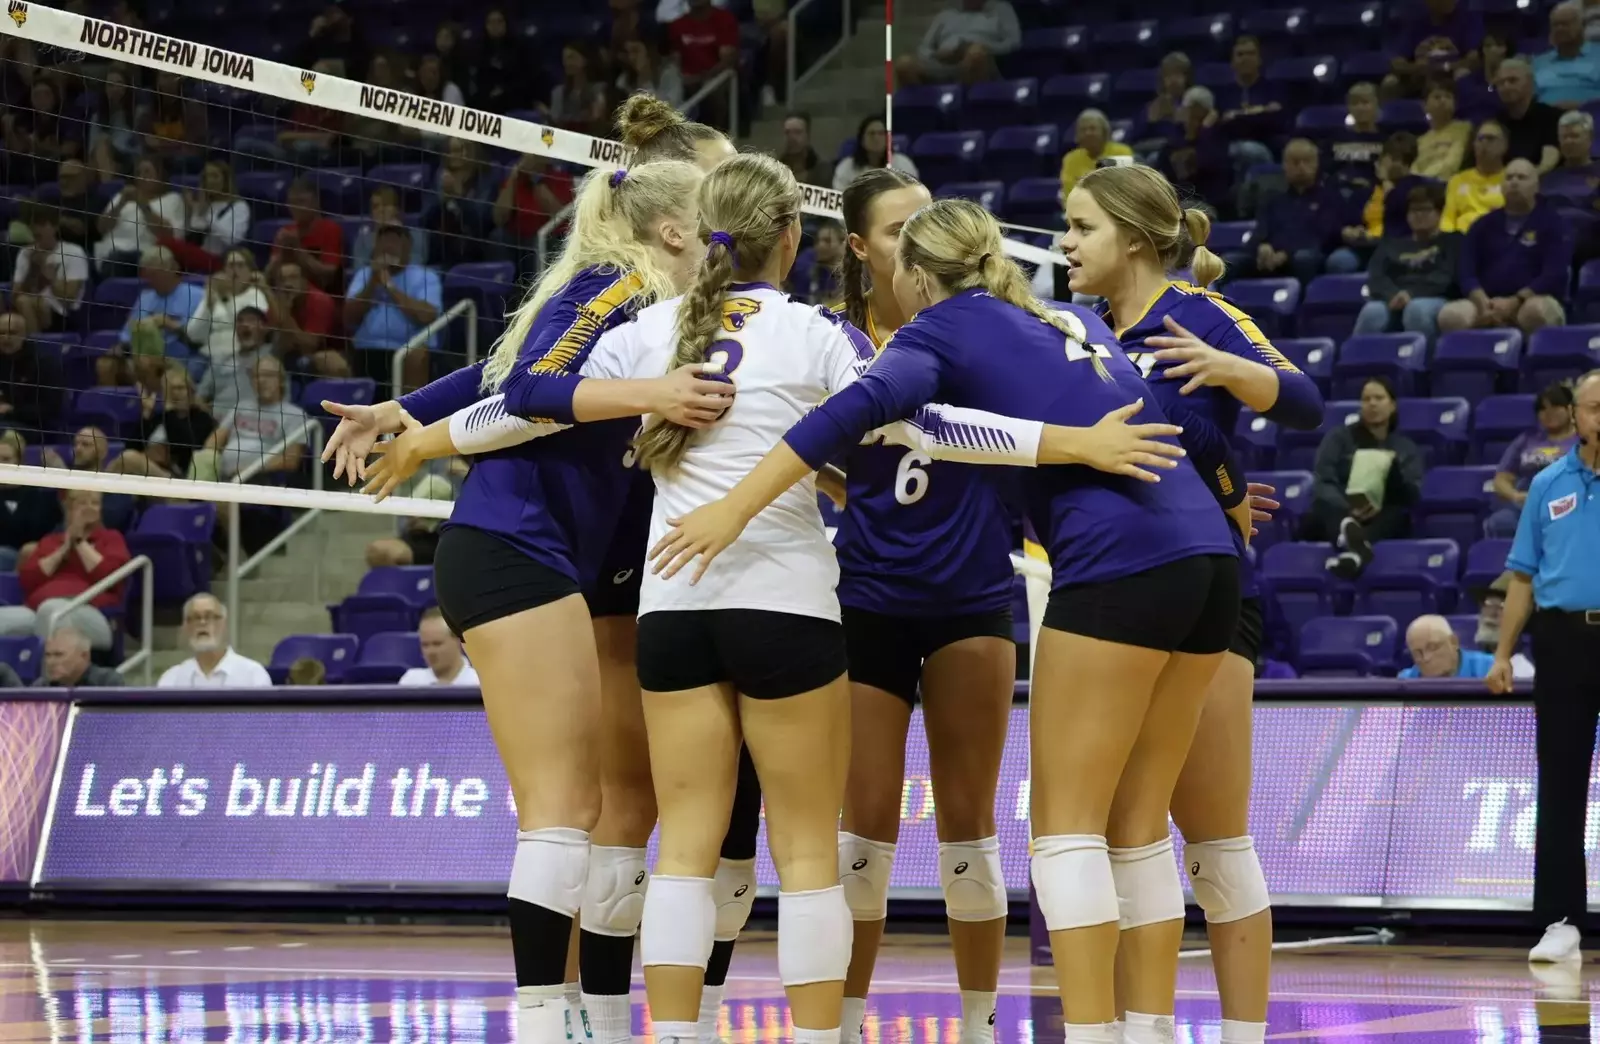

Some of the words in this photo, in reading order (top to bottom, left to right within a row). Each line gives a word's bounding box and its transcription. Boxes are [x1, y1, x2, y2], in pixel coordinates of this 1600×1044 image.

[8, 0, 28, 13] UNI
[80, 19, 197, 68] NORTHERN
[202, 47, 254, 82] IOWA
[360, 85, 454, 127] NORTHERN
[459, 109, 502, 138] IOWA
[894, 450, 932, 505] 6
[75, 763, 208, 817] Let's
[225, 763, 376, 817] build
[391, 763, 488, 817] the
